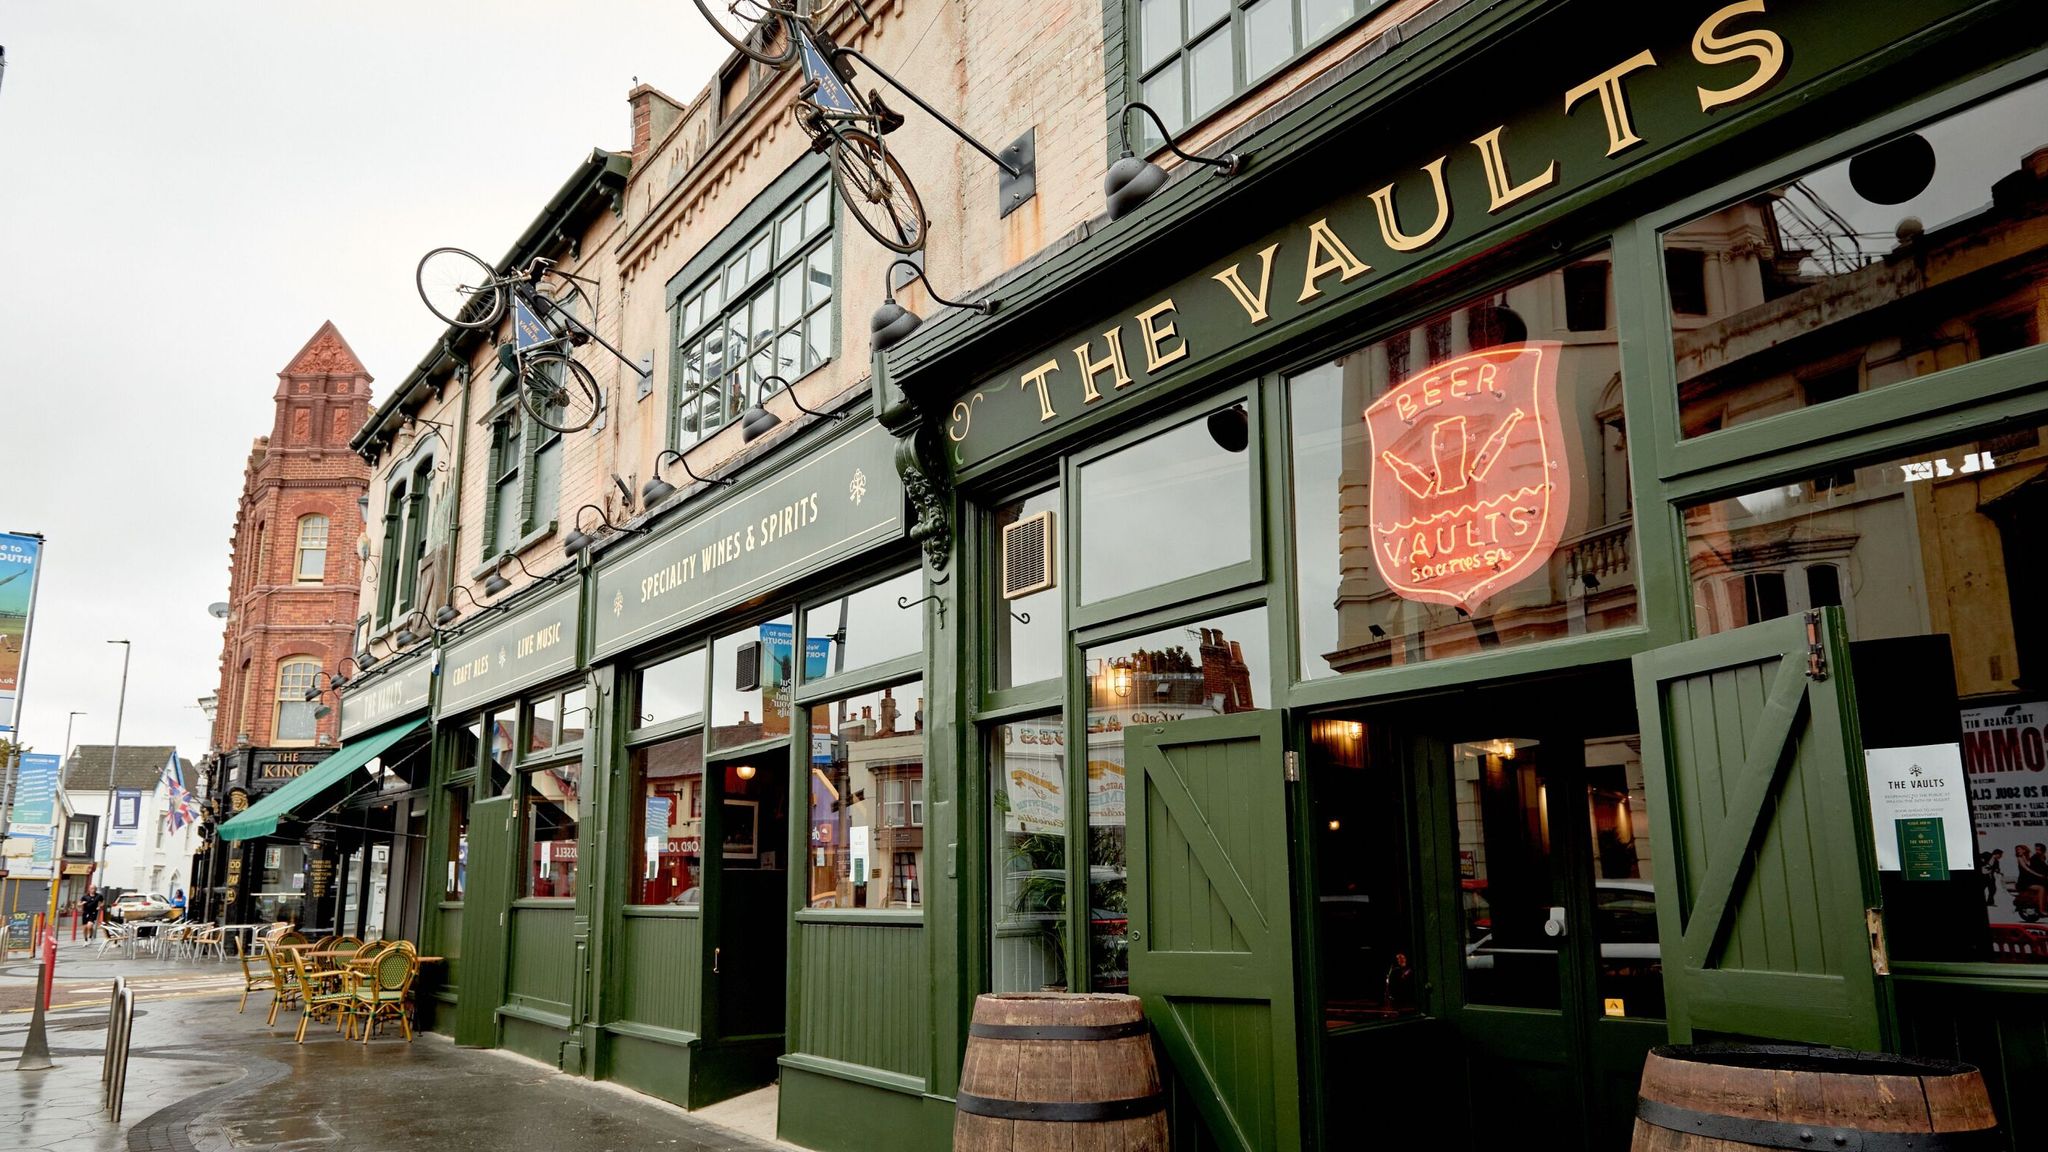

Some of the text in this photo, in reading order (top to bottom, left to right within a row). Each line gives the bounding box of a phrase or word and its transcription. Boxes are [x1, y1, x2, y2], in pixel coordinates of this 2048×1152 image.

[824, 74, 838, 94] THE
[1020, 0, 1788, 422] THE VAULTS
[1395, 363, 1497, 422] BEER
[10, 545, 22, 553] to
[640, 492, 819, 604] SPECIALTY WINES & SPIRITS
[1384, 507, 1528, 567] VAULTS
[452, 622, 561, 686] CRAFT ALES LIVE MUSIC
[276, 752, 299, 762] THE
[1888, 779, 1945, 789] THE VAULTS
